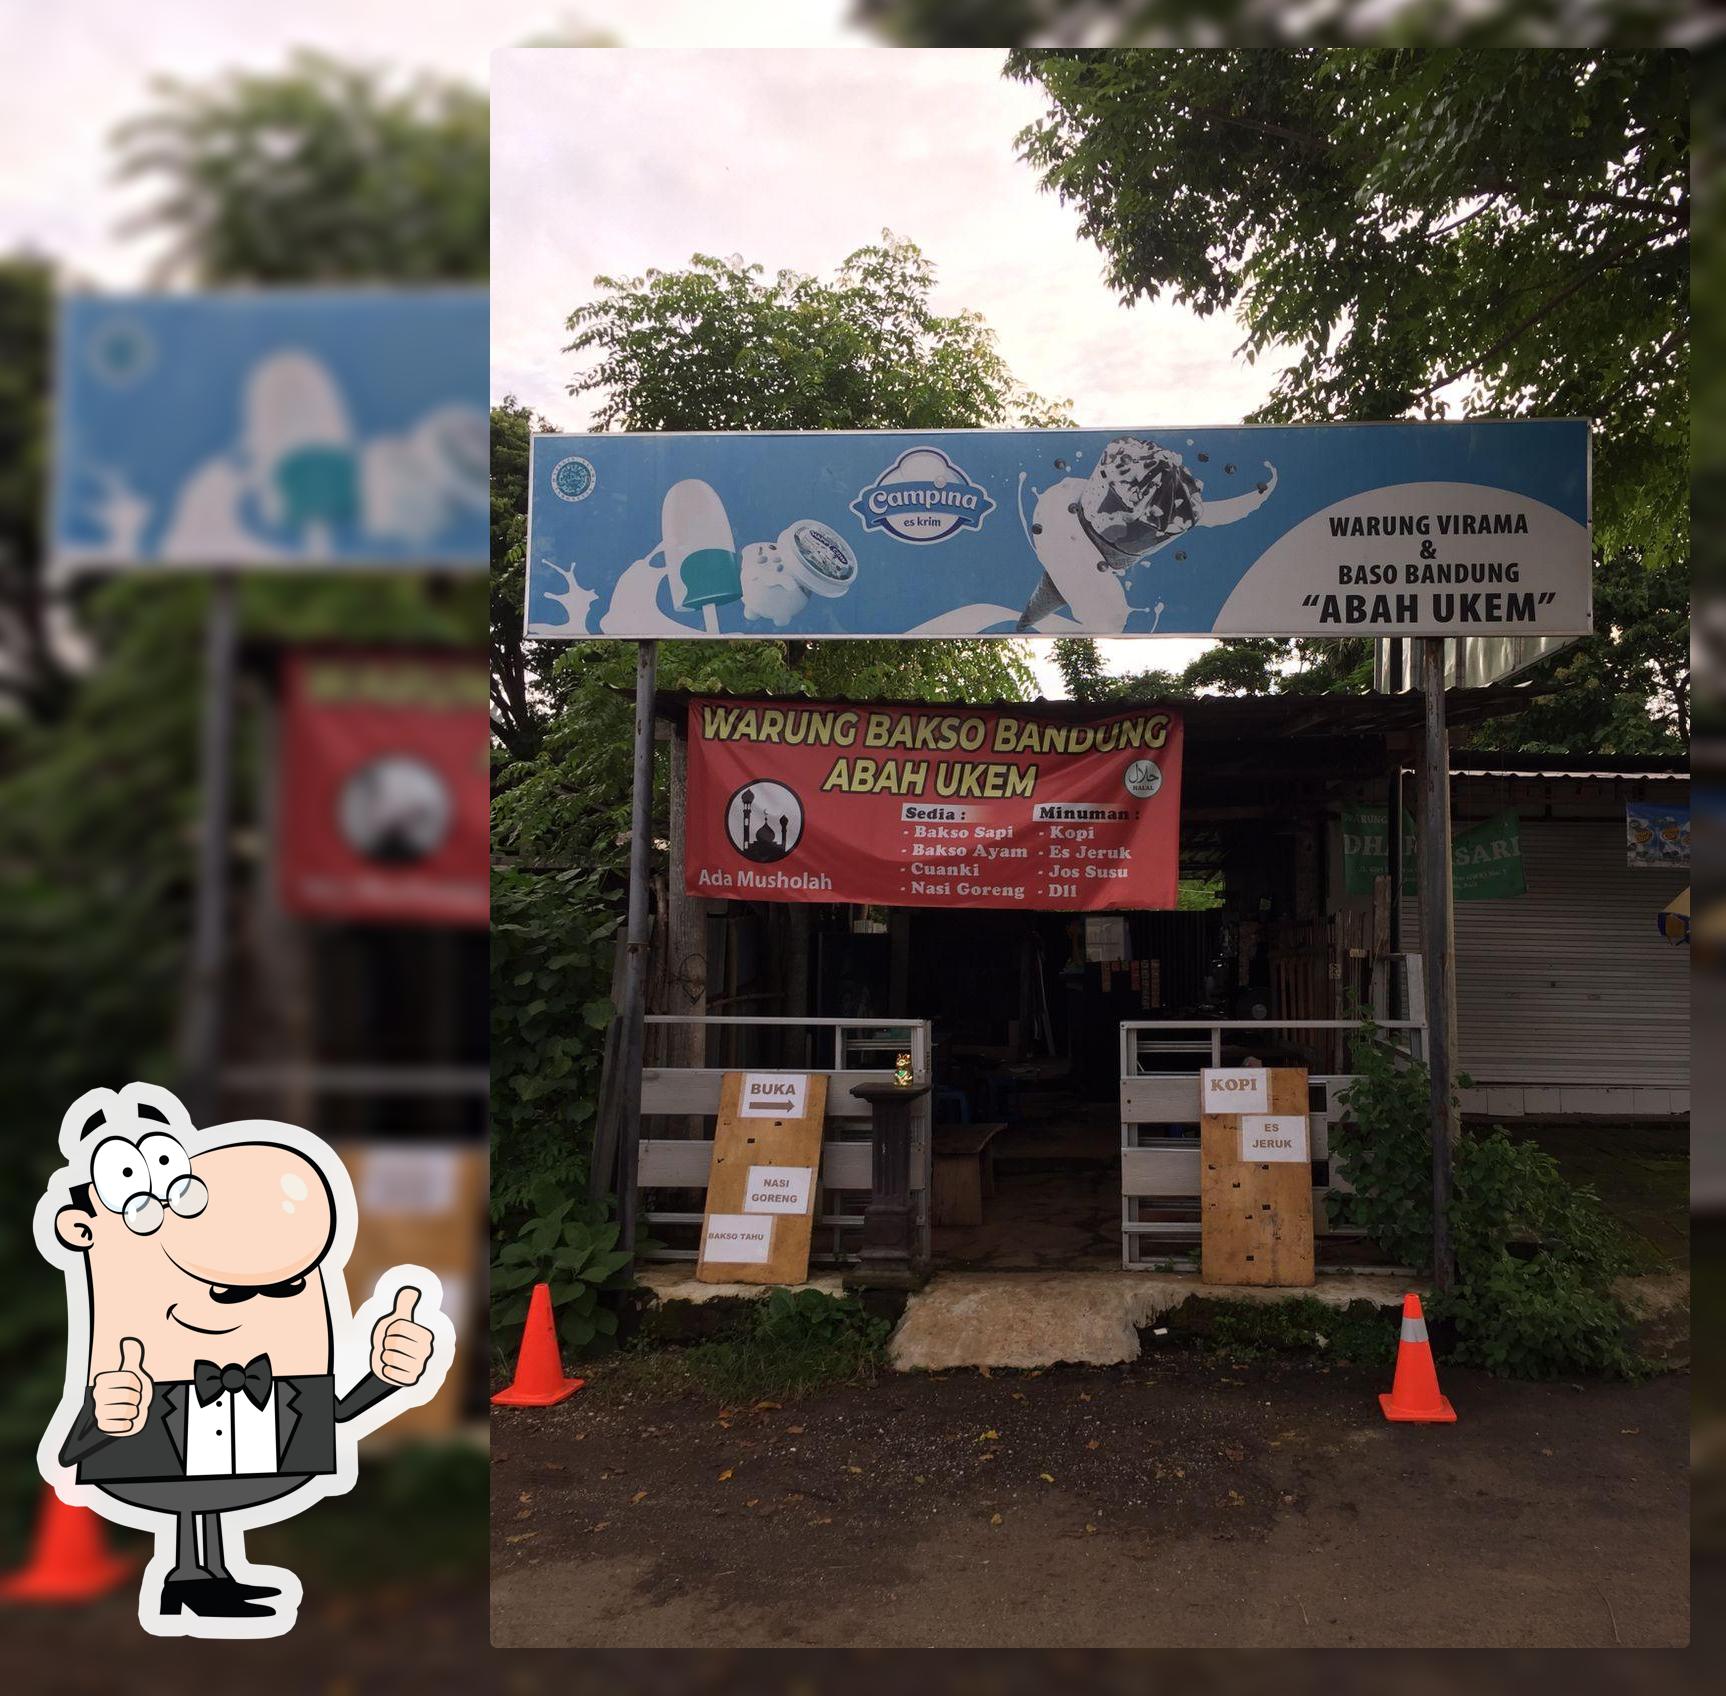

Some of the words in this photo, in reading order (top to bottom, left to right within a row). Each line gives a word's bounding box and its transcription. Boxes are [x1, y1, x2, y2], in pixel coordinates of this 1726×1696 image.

[868, 488, 978, 514] Campina
[903, 518, 915, 527] es
[917, 517, 941, 527] krim
[1329, 515, 1430, 536] WARUNG
[1437, 514, 1529, 535] VIRAMA
[1419, 539, 1437, 560] &
[1338, 564, 1398, 585] BASO
[1405, 562, 1520, 584] BANDUNG
[703, 706, 859, 746] WARUNG
[864, 713, 986, 751] BAKSO
[993, 714, 1169, 754] BANDUNG
[823, 757, 929, 795] ABAH
[935, 761, 1037, 798] UKEM
[905, 806, 955, 820] Sedia
[1039, 806, 1130, 820] Minuman
[914, 825, 969, 838] Bakso
[974, 826, 1013, 840] Sapi
[1050, 826, 1095, 841] Kopi
[912, 843, 967, 856] Bakso
[972, 844, 1028, 859] Ayam
[1049, 845, 1070, 858] Es
[1075, 846, 1132, 859] Jeruk
[1455, 836, 1521, 866] SARI
[911, 862, 980, 876] Cuanki
[1048, 865, 1080, 878] Jos
[1085, 865, 1128, 878] Susu
[699, 869, 732, 886] Ada
[737, 871, 833, 890] Musholah
[911, 881, 951, 895] Nasi
[957, 882, 1025, 899] Goreng
[750, 1083, 796, 1096] BUKA
[1210, 1078, 1258, 1091] KOPI
[1264, 1123, 1280, 1132] ES
[1252, 1139, 1292, 1149] JERUK
[763, 1178, 790, 1188] NASI
[751, 1193, 798, 1204] GORENG
[707, 1232, 738, 1240] BAKSO
[740, 1233, 764, 1241] TAHU
